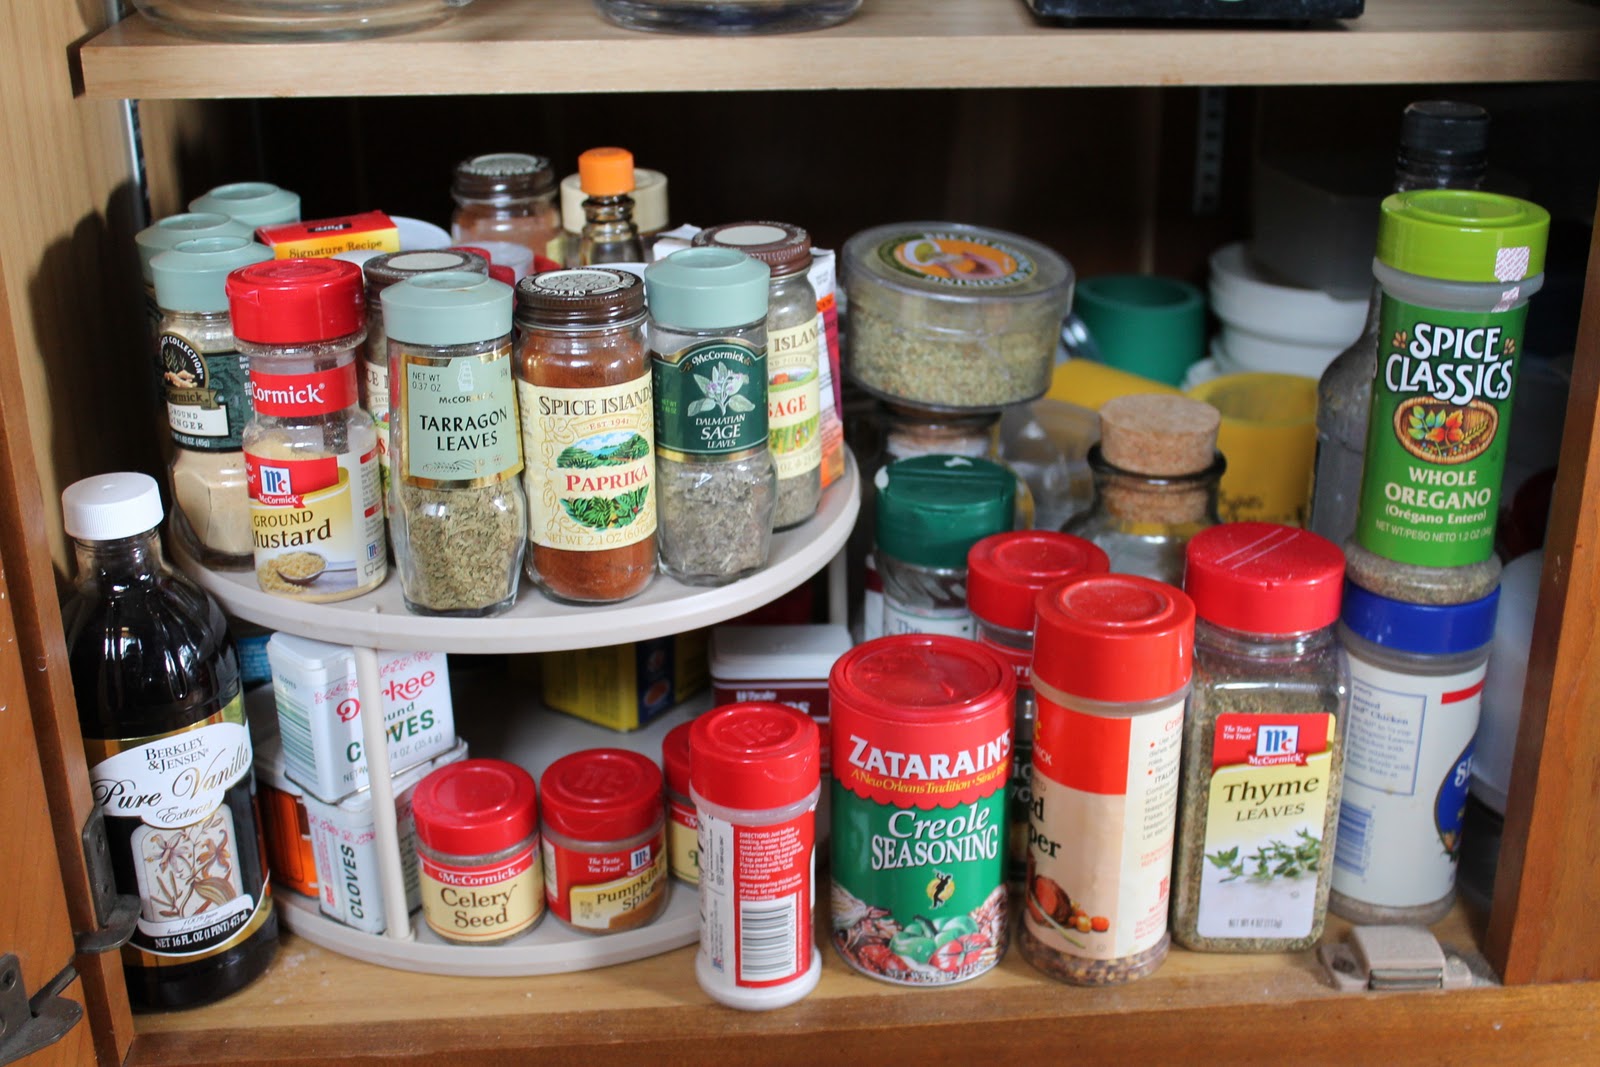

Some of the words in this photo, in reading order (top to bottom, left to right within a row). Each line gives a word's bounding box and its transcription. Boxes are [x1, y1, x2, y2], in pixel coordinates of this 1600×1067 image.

[289, 245, 343, 259] Signature
[347, 239, 382, 252] Recipe
[774, 328, 818, 352] ISLAN
[1410, 323, 1501, 363] SPICE
[168, 336, 204, 375] COLLECTION
[691, 350, 745, 367] McCormick
[412, 371, 426, 381] NET
[429, 374, 441, 382] WT
[412, 382, 428, 391] 0.37
[430, 383, 442, 392] OZ
[1386, 353, 1513, 405] CLASSICS
[252, 380, 326, 404] Cormick
[538, 395, 597, 416] SPICE
[419, 406, 509, 432] TARRAGON
[695, 413, 746, 426] DALMATIAN
[437, 430, 498, 452] LEAVES
[700, 424, 741, 440] SAGE
[707, 439, 736, 449] LEAVES
[565, 464, 649, 492] PAPRIKA
[1409, 466, 1477, 486] WHOLE
[258, 493, 299, 505] McCormick
[1384, 482, 1491, 510] OREGANO
[253, 510, 314, 528] GROUND
[1432, 532, 1457, 543] NETO
[1223, 732, 1236, 740] You
[1236, 732, 1252, 740] Trust
[1236, 725, 1252, 733] Taste
[145, 736, 205, 762] BERKLEY
[848, 728, 1011, 780] ZATARAIN'S
[1248, 754, 1304, 766] McCormick
[93, 778, 162, 809] Pure
[172, 746, 250, 800] Vanilla
[883, 779, 925, 794] Orleans
[927, 780, 971, 794] Tradition
[976, 772, 996, 786] Since
[1223, 777, 1320, 806] Thyme
[156, 800, 214, 823] Extract
[888, 803, 990, 840] Creole
[1236, 804, 1306, 822] LEAVES
[871, 824, 998, 870] SEASONING
[340, 844, 365, 920] CLOVES
[438, 868, 517, 885] McCormick
[597, 866, 658, 905] Pumpkin
[440, 884, 518, 908] Celery
[454, 902, 508, 929] Seed
[155, 937, 170, 949] NET
[172, 936, 181, 947] 16
[193, 930, 203, 942] OZ
